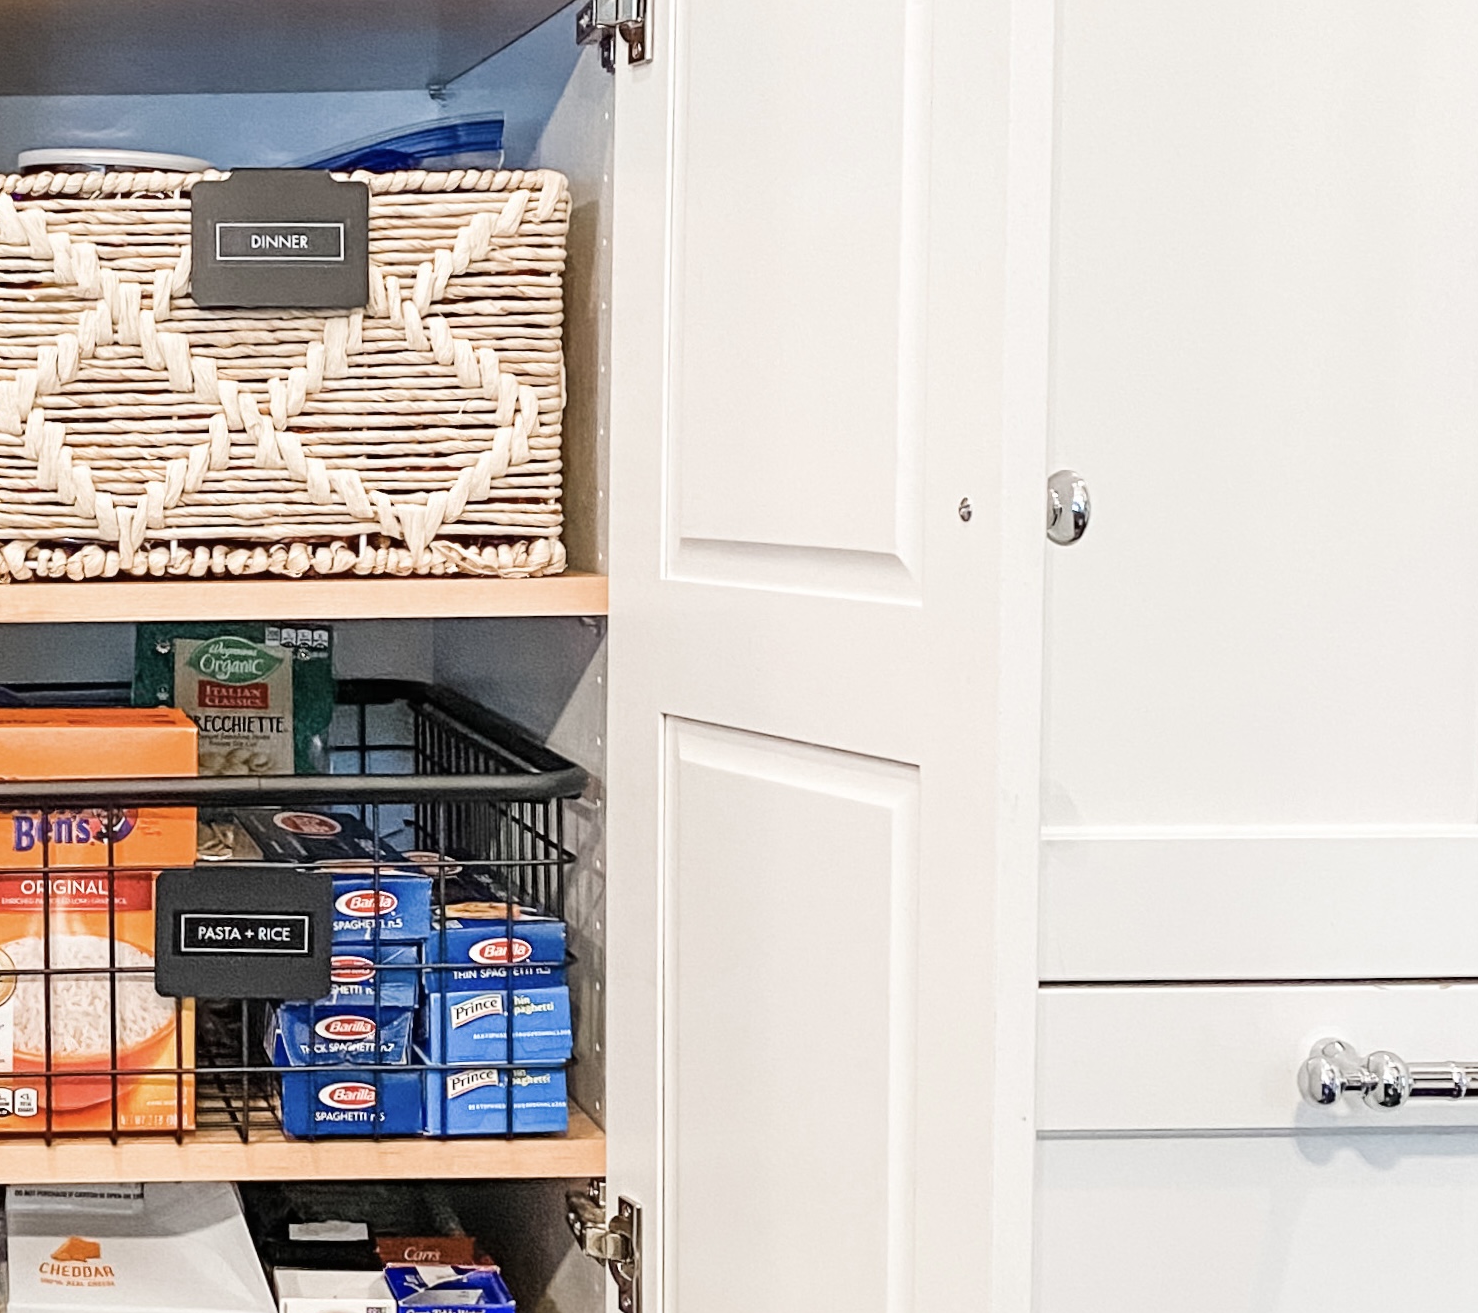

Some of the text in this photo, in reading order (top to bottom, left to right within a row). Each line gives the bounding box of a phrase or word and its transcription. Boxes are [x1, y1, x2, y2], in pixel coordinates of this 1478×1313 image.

[250, 234, 309, 250] DINNER
[199, 654, 265, 680] Organic
[204, 685, 262, 698] ITALIAN
[20, 879, 108, 895] ORIGINAL
[348, 895, 393, 910] Barla
[333, 919, 385, 932] SPAGHETI
[197, 925, 291, 942] PASTA + RICE
[483, 944, 528, 959] Barla
[452, 970, 478, 981] THIN
[454, 997, 499, 1021] Prince
[512, 1002, 556, 1016] paghetti
[328, 1020, 376, 1034] Barilla
[450, 1070, 495, 1091] Prince
[332, 1088, 376, 1102] Barilla
[314, 1111, 368, 1122] SPAGHETTI
[38, 1261, 116, 1278] CHEDDAR
